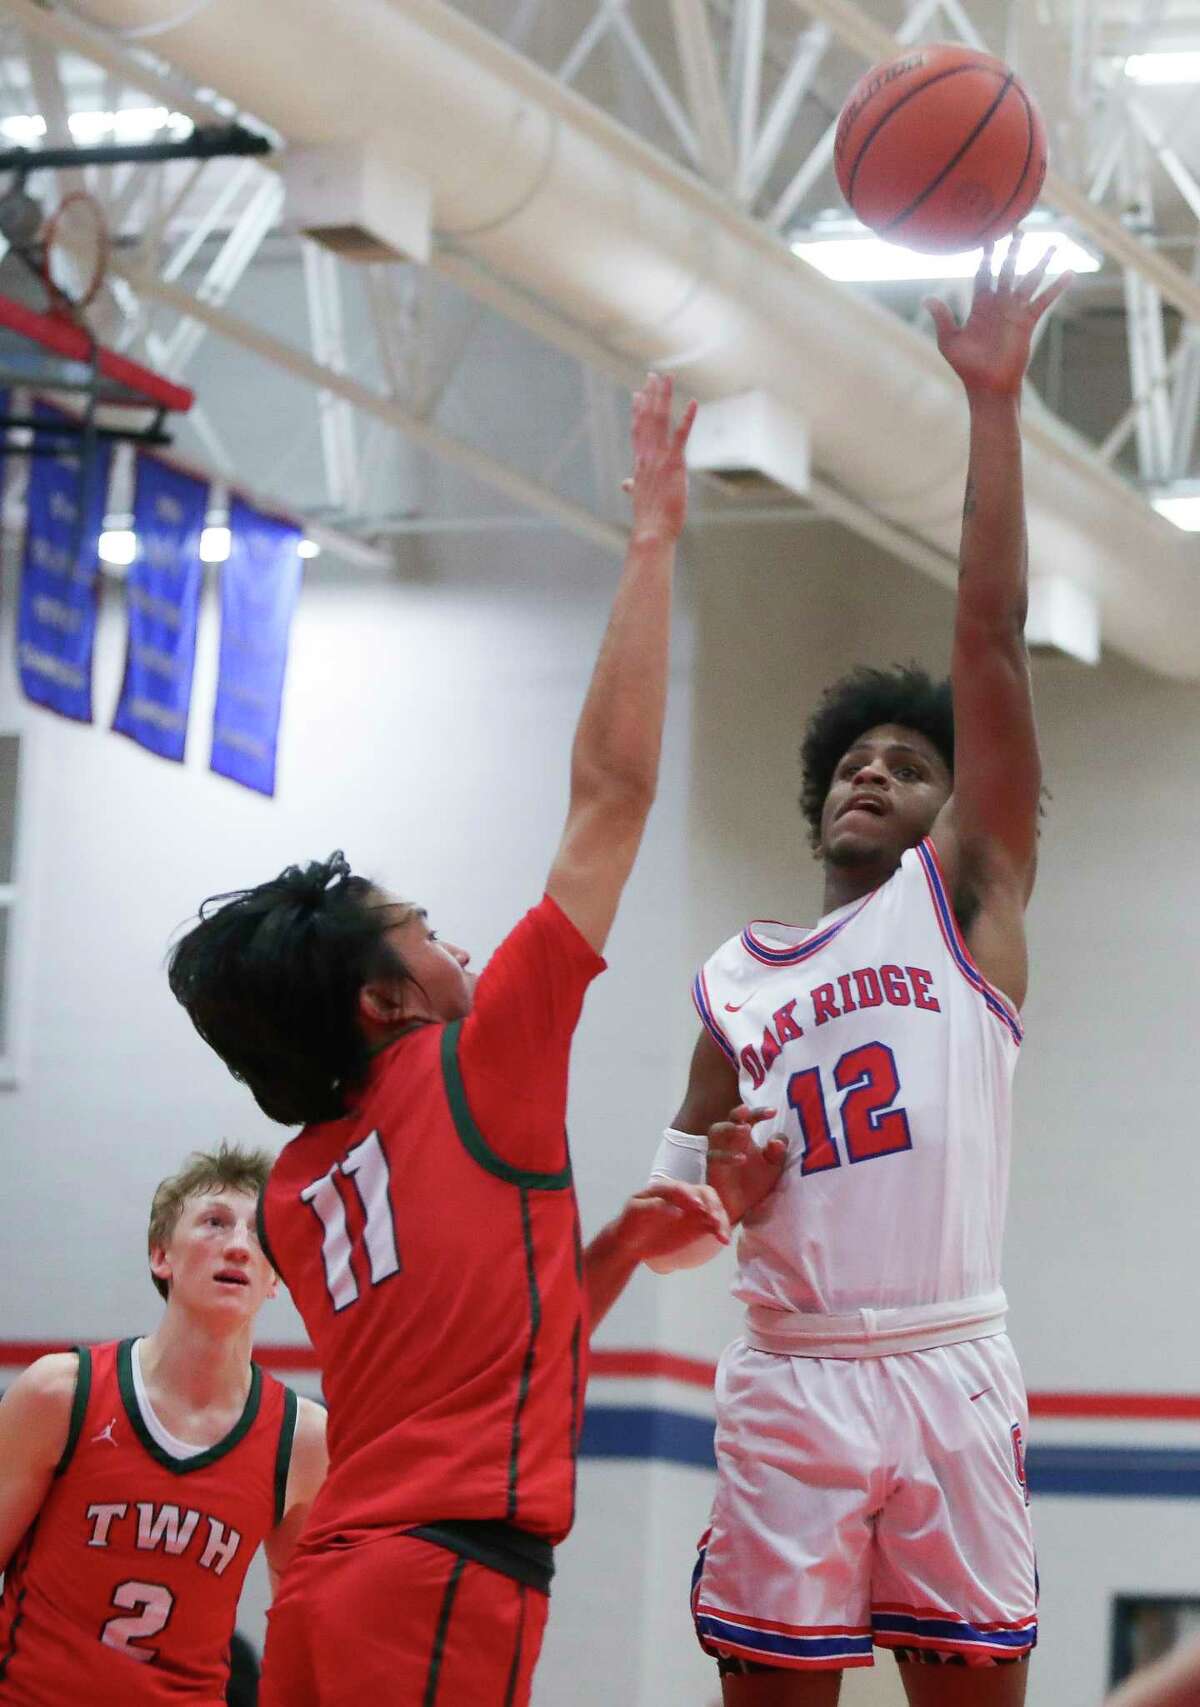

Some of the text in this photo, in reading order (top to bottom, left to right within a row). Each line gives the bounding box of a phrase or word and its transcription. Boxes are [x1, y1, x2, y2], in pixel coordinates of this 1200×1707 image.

[740, 964, 941, 1091] OAK RIDGE
[786, 1040, 913, 1177] 12
[299, 1128, 401, 1314] 11
[86, 1502, 242, 1577] TWH
[100, 1580, 175, 1662] 2
